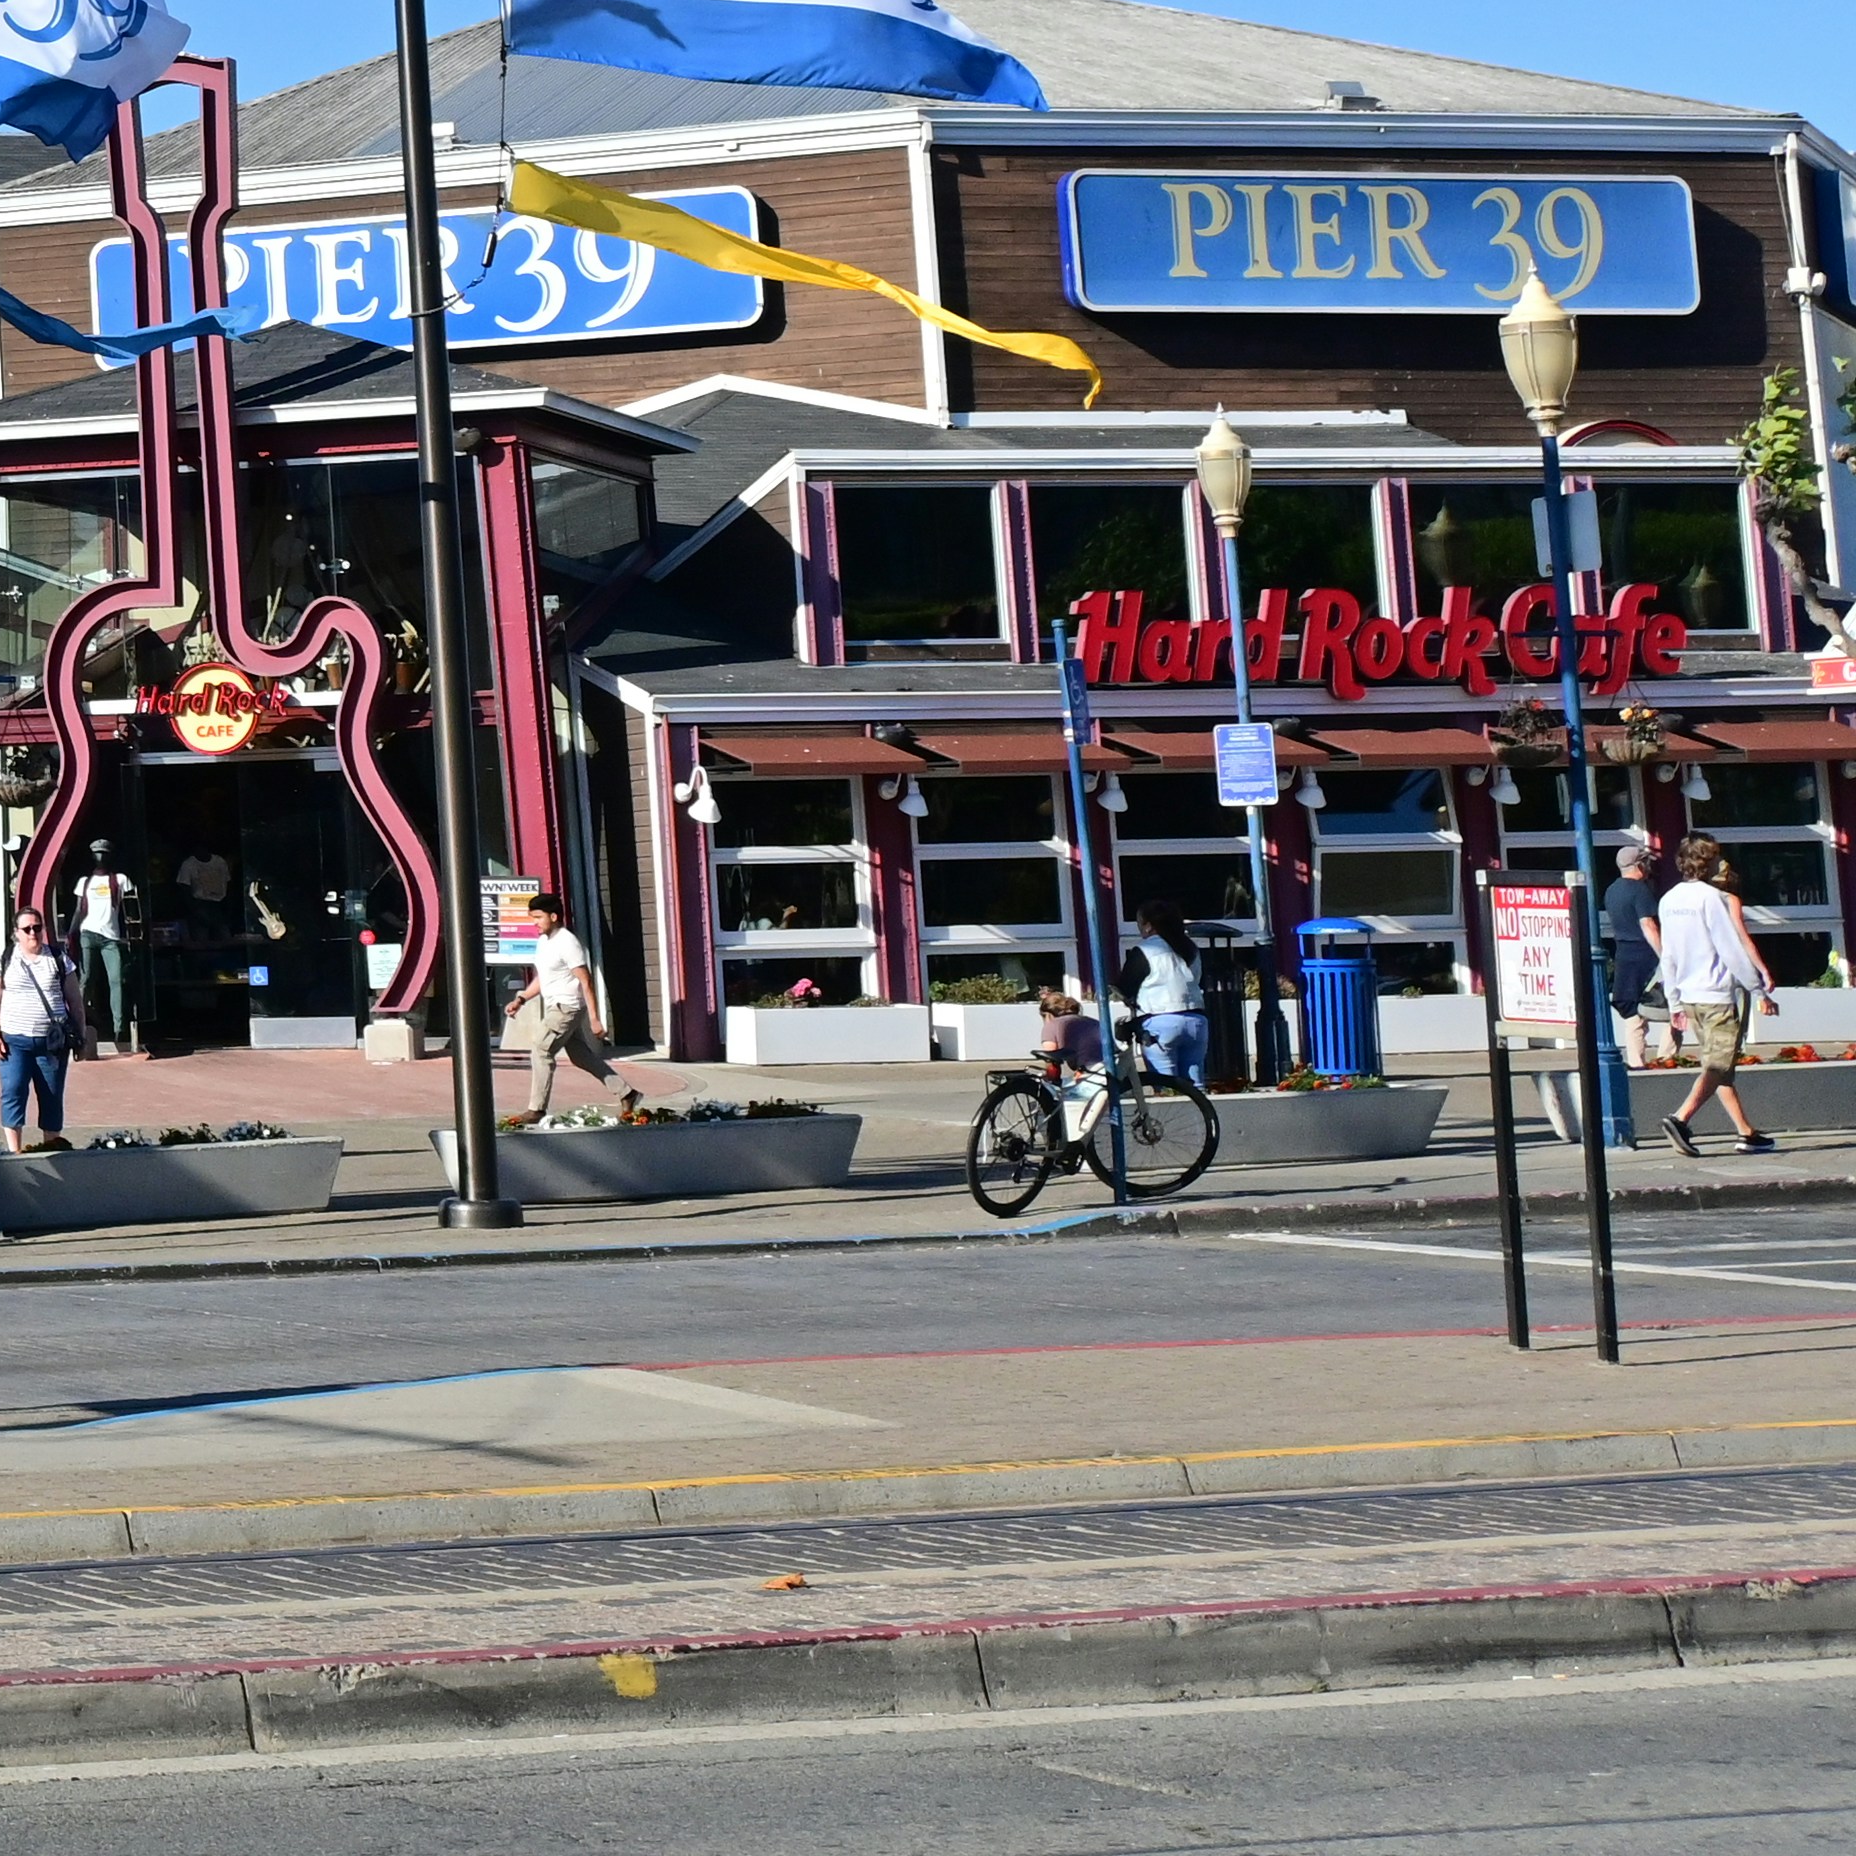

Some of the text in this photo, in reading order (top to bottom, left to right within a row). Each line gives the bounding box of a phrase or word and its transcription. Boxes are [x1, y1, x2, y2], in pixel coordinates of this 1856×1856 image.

[1161, 182, 1604, 302] PIER 39
[493, 215, 657, 334] 39
[1068, 582, 1688, 701] Hard Rock Cafe
[136, 680, 289, 718] Hard Rock
[196, 724, 235, 738] CAFE
[507, 883, 538, 892] WEEK
[1499, 887, 1566, 906] TOW-AWAY
[1496, 907, 1572, 939] NO STOPPING
[1522, 945, 1552, 969] ANY
[1520, 972, 1557, 997] TIME
